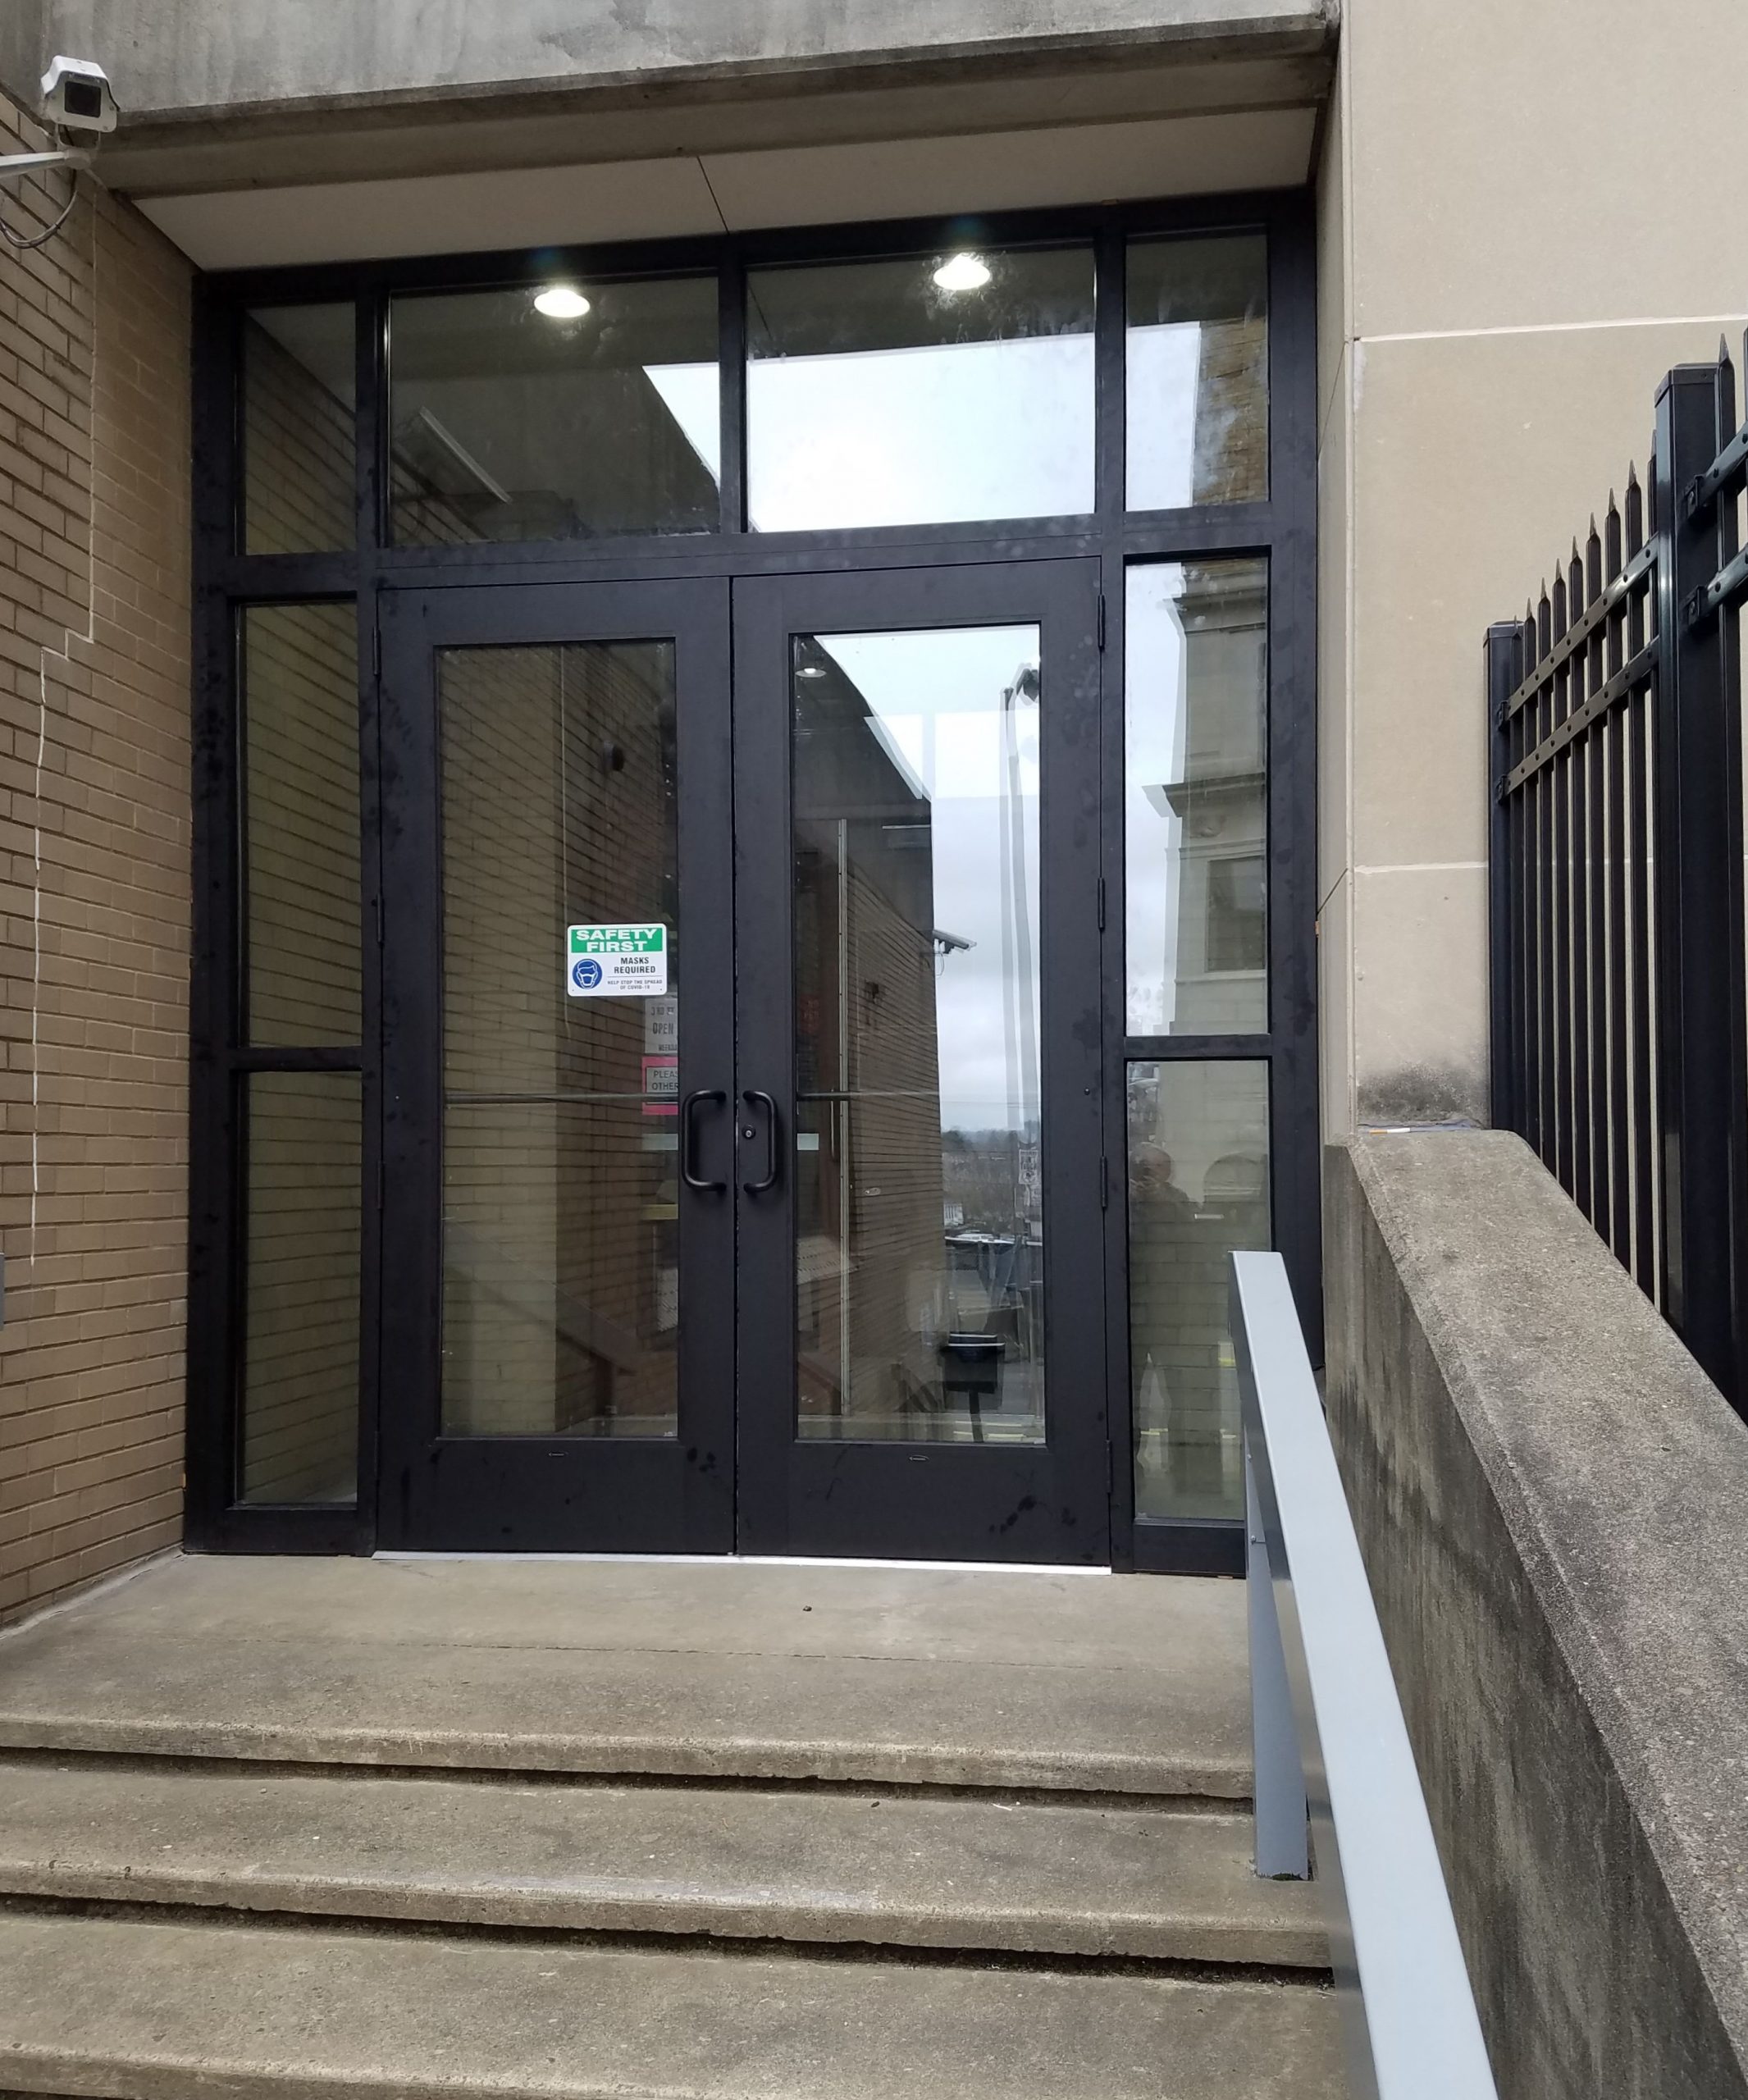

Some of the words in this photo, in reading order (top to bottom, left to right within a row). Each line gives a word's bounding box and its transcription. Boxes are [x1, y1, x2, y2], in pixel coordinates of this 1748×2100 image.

[576, 929, 657, 940] SAFETY
[586, 941, 647, 952] FIRST
[620, 956, 649, 965] MASKS
[614, 966, 656, 974] REQUIRED
[652, 1022, 674, 1034] OPEN
